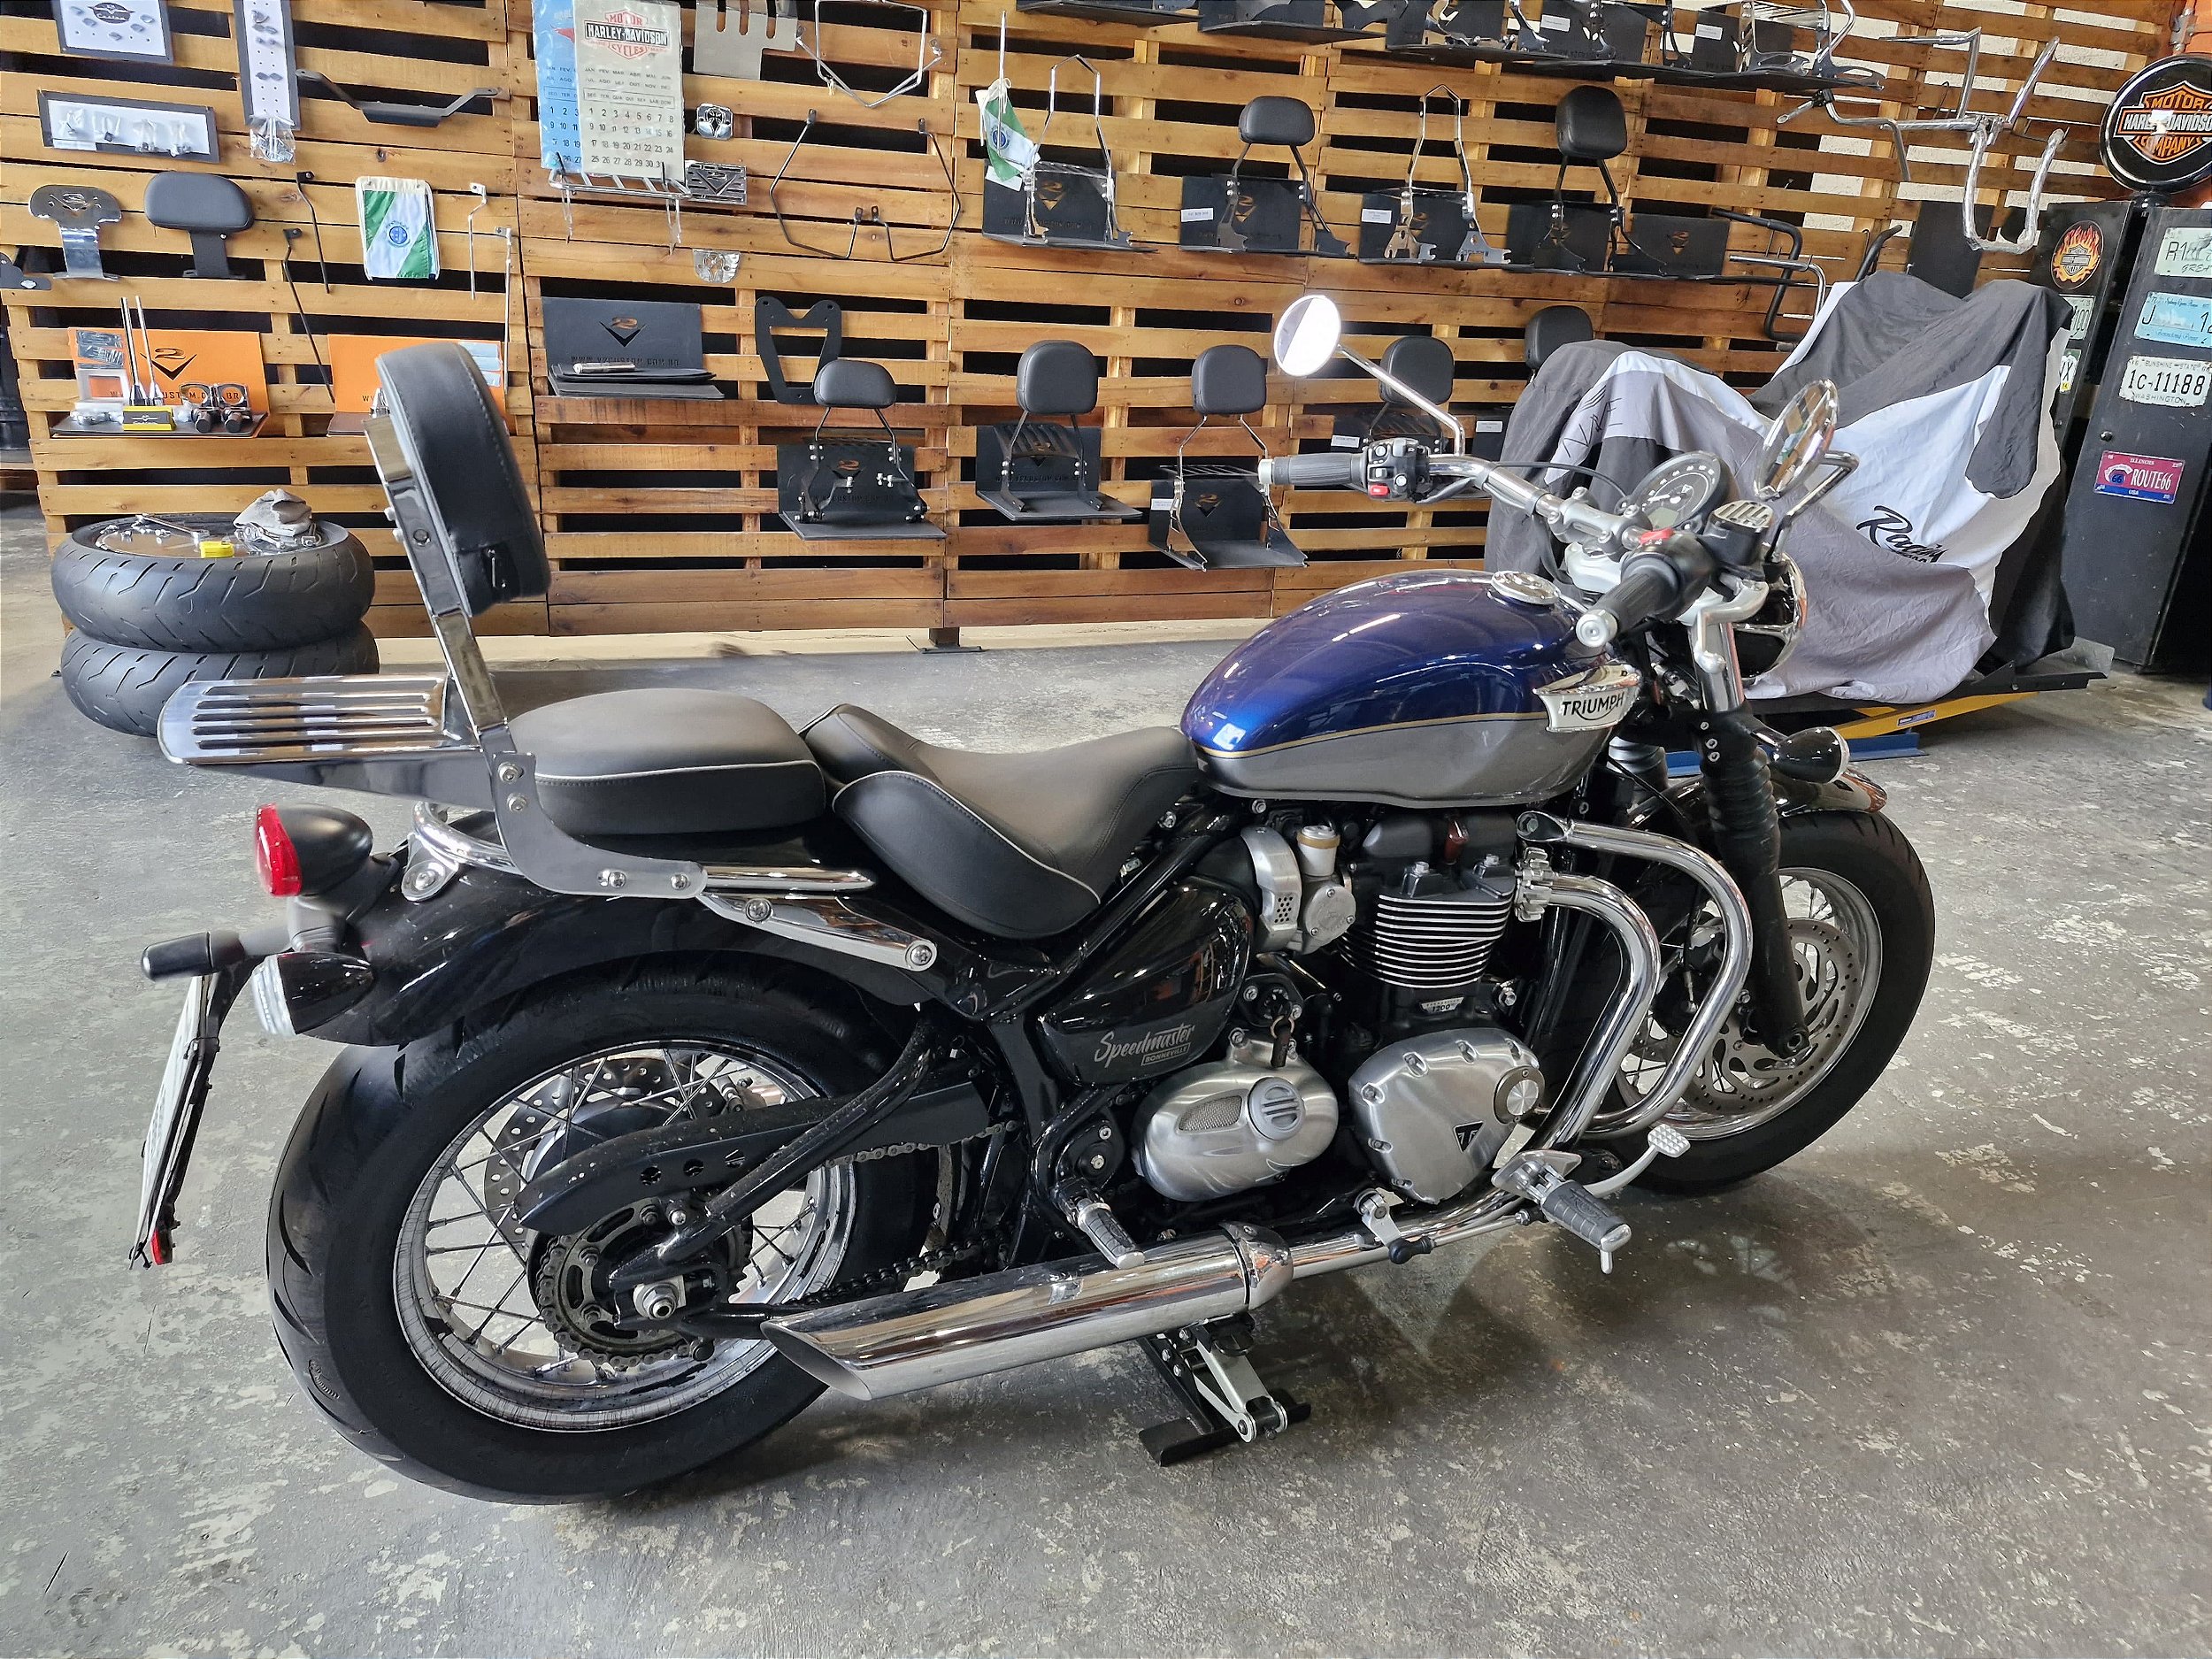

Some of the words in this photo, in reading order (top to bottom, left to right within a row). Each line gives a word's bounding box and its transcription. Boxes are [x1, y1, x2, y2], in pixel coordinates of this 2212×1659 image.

[587, 24, 669, 46] HARLEY-DAVIDSON
[2150, 90, 2205, 110] MOTOR
[599, 123, 606, 132] 10
[622, 125, 629, 134] 12
[666, 129, 673, 138] 16
[2123, 112, 2212, 134] HARLDAVIDSO
[563, 139, 570, 148] 18
[573, 140, 581, 149] 19
[622, 142, 631, 150] 20
[634, 142, 641, 151] 21
[644, 143, 652, 152] 22
[655, 144, 663, 153] 23
[602, 156, 611, 165] 26
[613, 157, 621, 165] 27
[624, 157, 632, 166] 28
[634, 158, 643, 167] 29
[645, 159, 654, 168] 30
[2142, 304, 2156, 325] J
[1562, 691, 1624, 721] TRIUMPH
[1094, 1023, 1196, 1069] Speedmaster
[1144, 1046, 1187, 1062] BONNEVILLE
